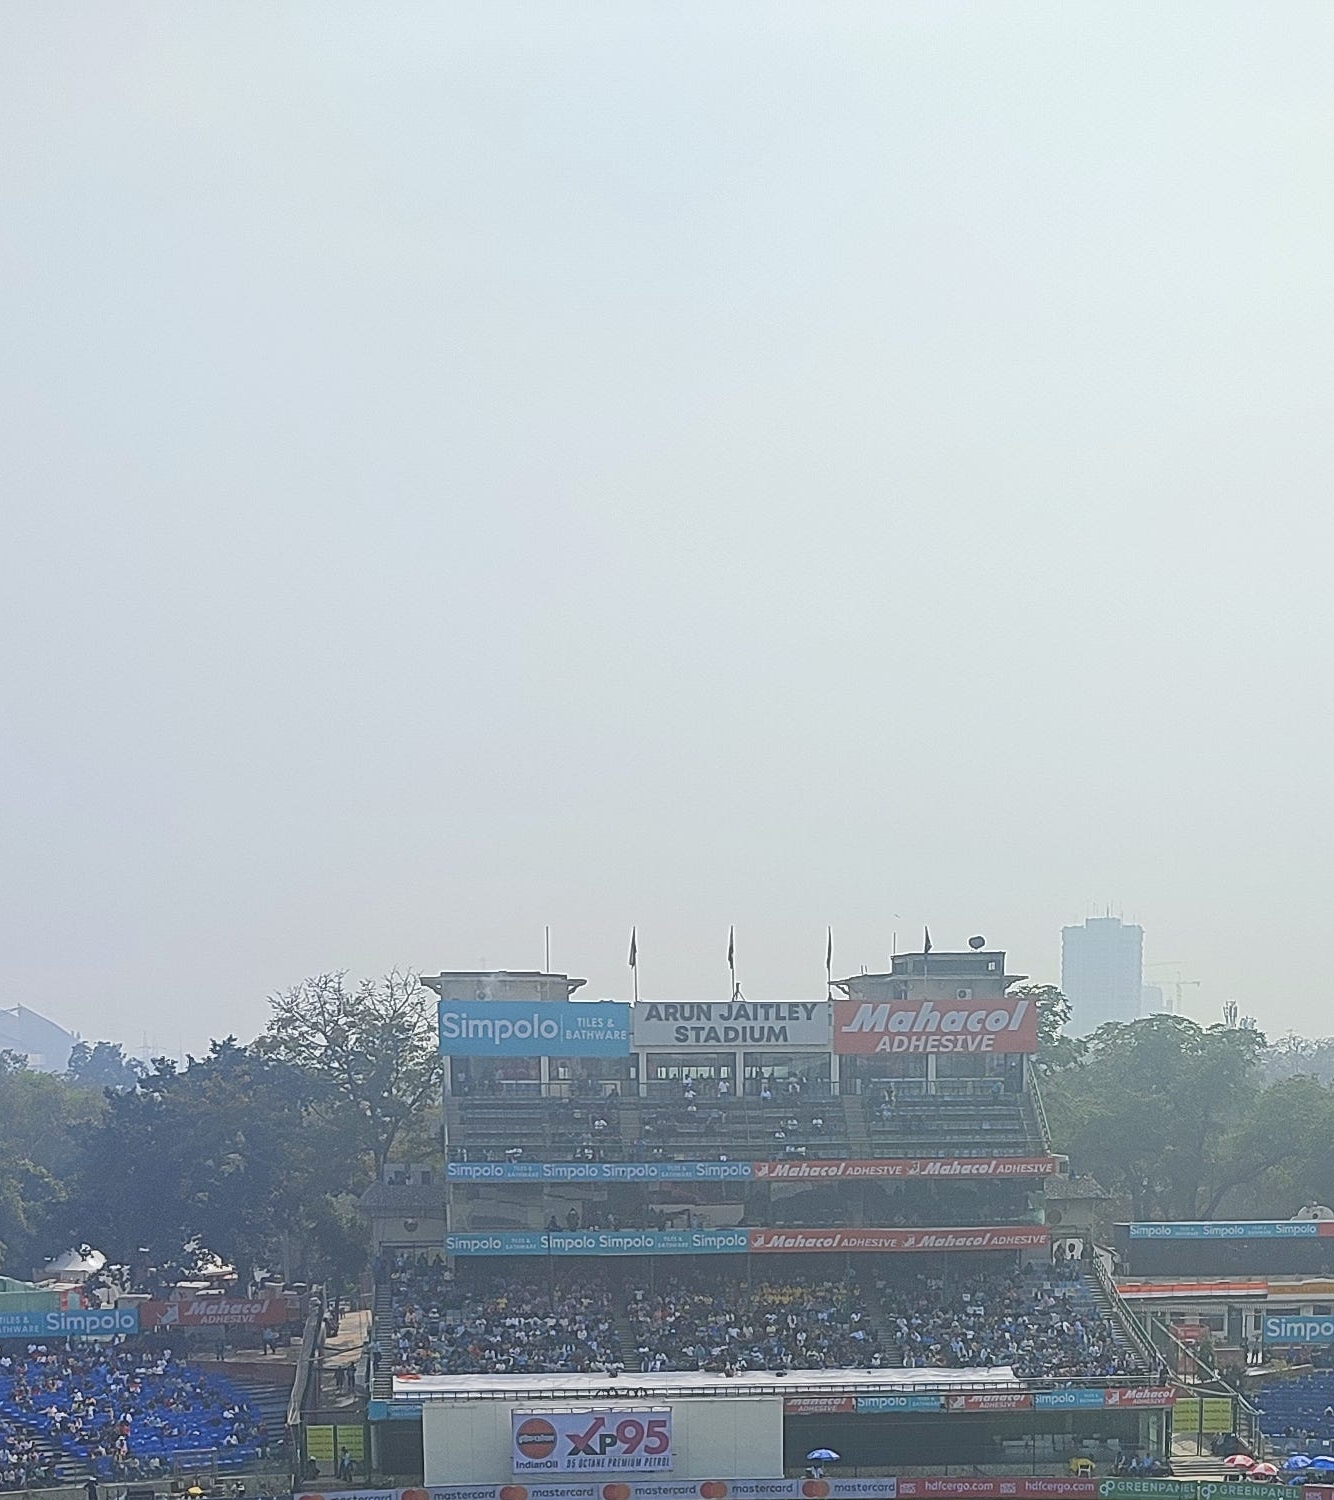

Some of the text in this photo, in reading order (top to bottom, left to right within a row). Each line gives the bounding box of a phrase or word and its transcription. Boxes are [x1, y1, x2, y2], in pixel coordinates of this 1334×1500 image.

[645, 1003, 817, 1022] ARUN JAITLEY
[841, 1000, 1029, 1033] Mahacol
[442, 1012, 559, 1045] Simpolo
[577, 1017, 615, 1028] TILES &
[565, 1030, 627, 1041] BATHWARE
[674, 1025, 788, 1043] STADIUM
[875, 1034, 995, 1052] ADHESIVE
[447, 1163, 503, 1178] Simpolo
[543, 1164, 658, 1179] Simpolo Simpolo
[696, 1163, 751, 1177] Simpolo
[770, 1163, 902, 1177] Mahacol ADHESIVE
[921, 1161, 1053, 1175] Mahacol ADHESIVE
[1130, 1225, 1171, 1237] Simpolo
[1203, 1225, 1244, 1237] Simpolo
[1276, 1224, 1317, 1236] Simpolo
[446, 1237, 502, 1251] Simpolo
[540, 1235, 654, 1250] Simpolo Simpolo
[692, 1233, 747, 1248] Simpolo
[767, 1235, 897, 1248] Mahacol ADHESIVE
[917, 1233, 1046, 1247] Mahacol ADHESIVE
[184, 1299, 268, 1316] Mahacol
[46, 1310, 135, 1332] Simpolo
[201, 1313, 255, 1324] ADHESIVE
[1122, 1389, 1175, 1400] Mahacol
[566, 1417, 669, 1456] XP95
[516, 1460, 559, 1469] IndianOil
[579, 1458, 605, 1468] OCTANE
[608, 1457, 642, 1468] PREMIUM
[644, 1457, 670, 1467] PETROL
[434, 1484, 496, 1500] mastercard
[532, 1487, 594, 1497] mastercard
[635, 1485, 696, 1495] mastercard
[732, 1483, 793, 1493] mastercard
[834, 1482, 895, 1493] mastercard
[925, 1481, 994, 1492] hdfcergo.com
[1025, 1481, 1095, 1492] hdfcergo.com
[1117, 1481, 1196, 1495] GREENPANEL
[1220, 1483, 1300, 1499] GREENPANEL
